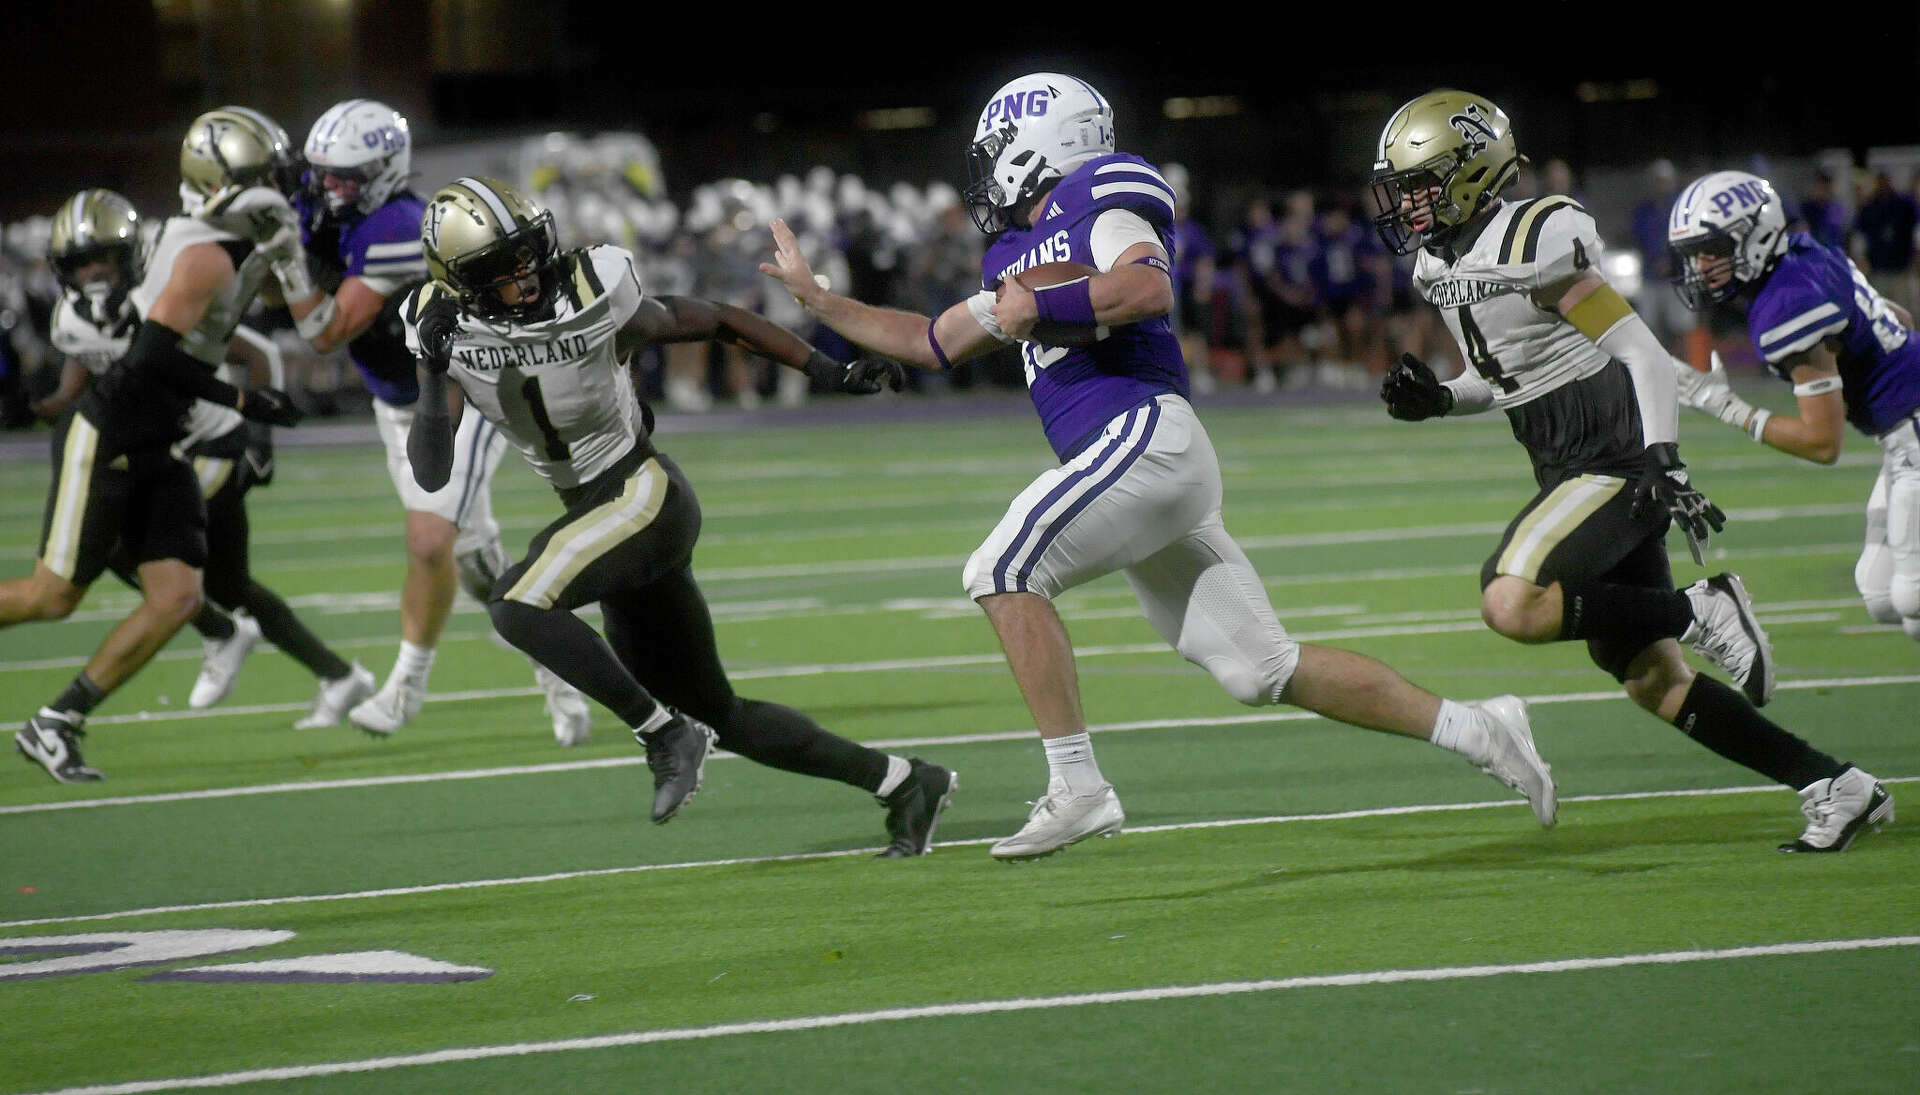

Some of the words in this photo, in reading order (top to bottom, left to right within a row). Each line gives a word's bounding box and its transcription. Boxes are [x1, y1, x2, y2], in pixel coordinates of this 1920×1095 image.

[984, 89, 1050, 132] PNG
[1710, 180, 1770, 219] PNG
[1572, 236, 1591, 271] 4
[459, 333, 588, 371] NEDERLAND
[1458, 303, 1521, 395] 4
[521, 375, 572, 462] 1
